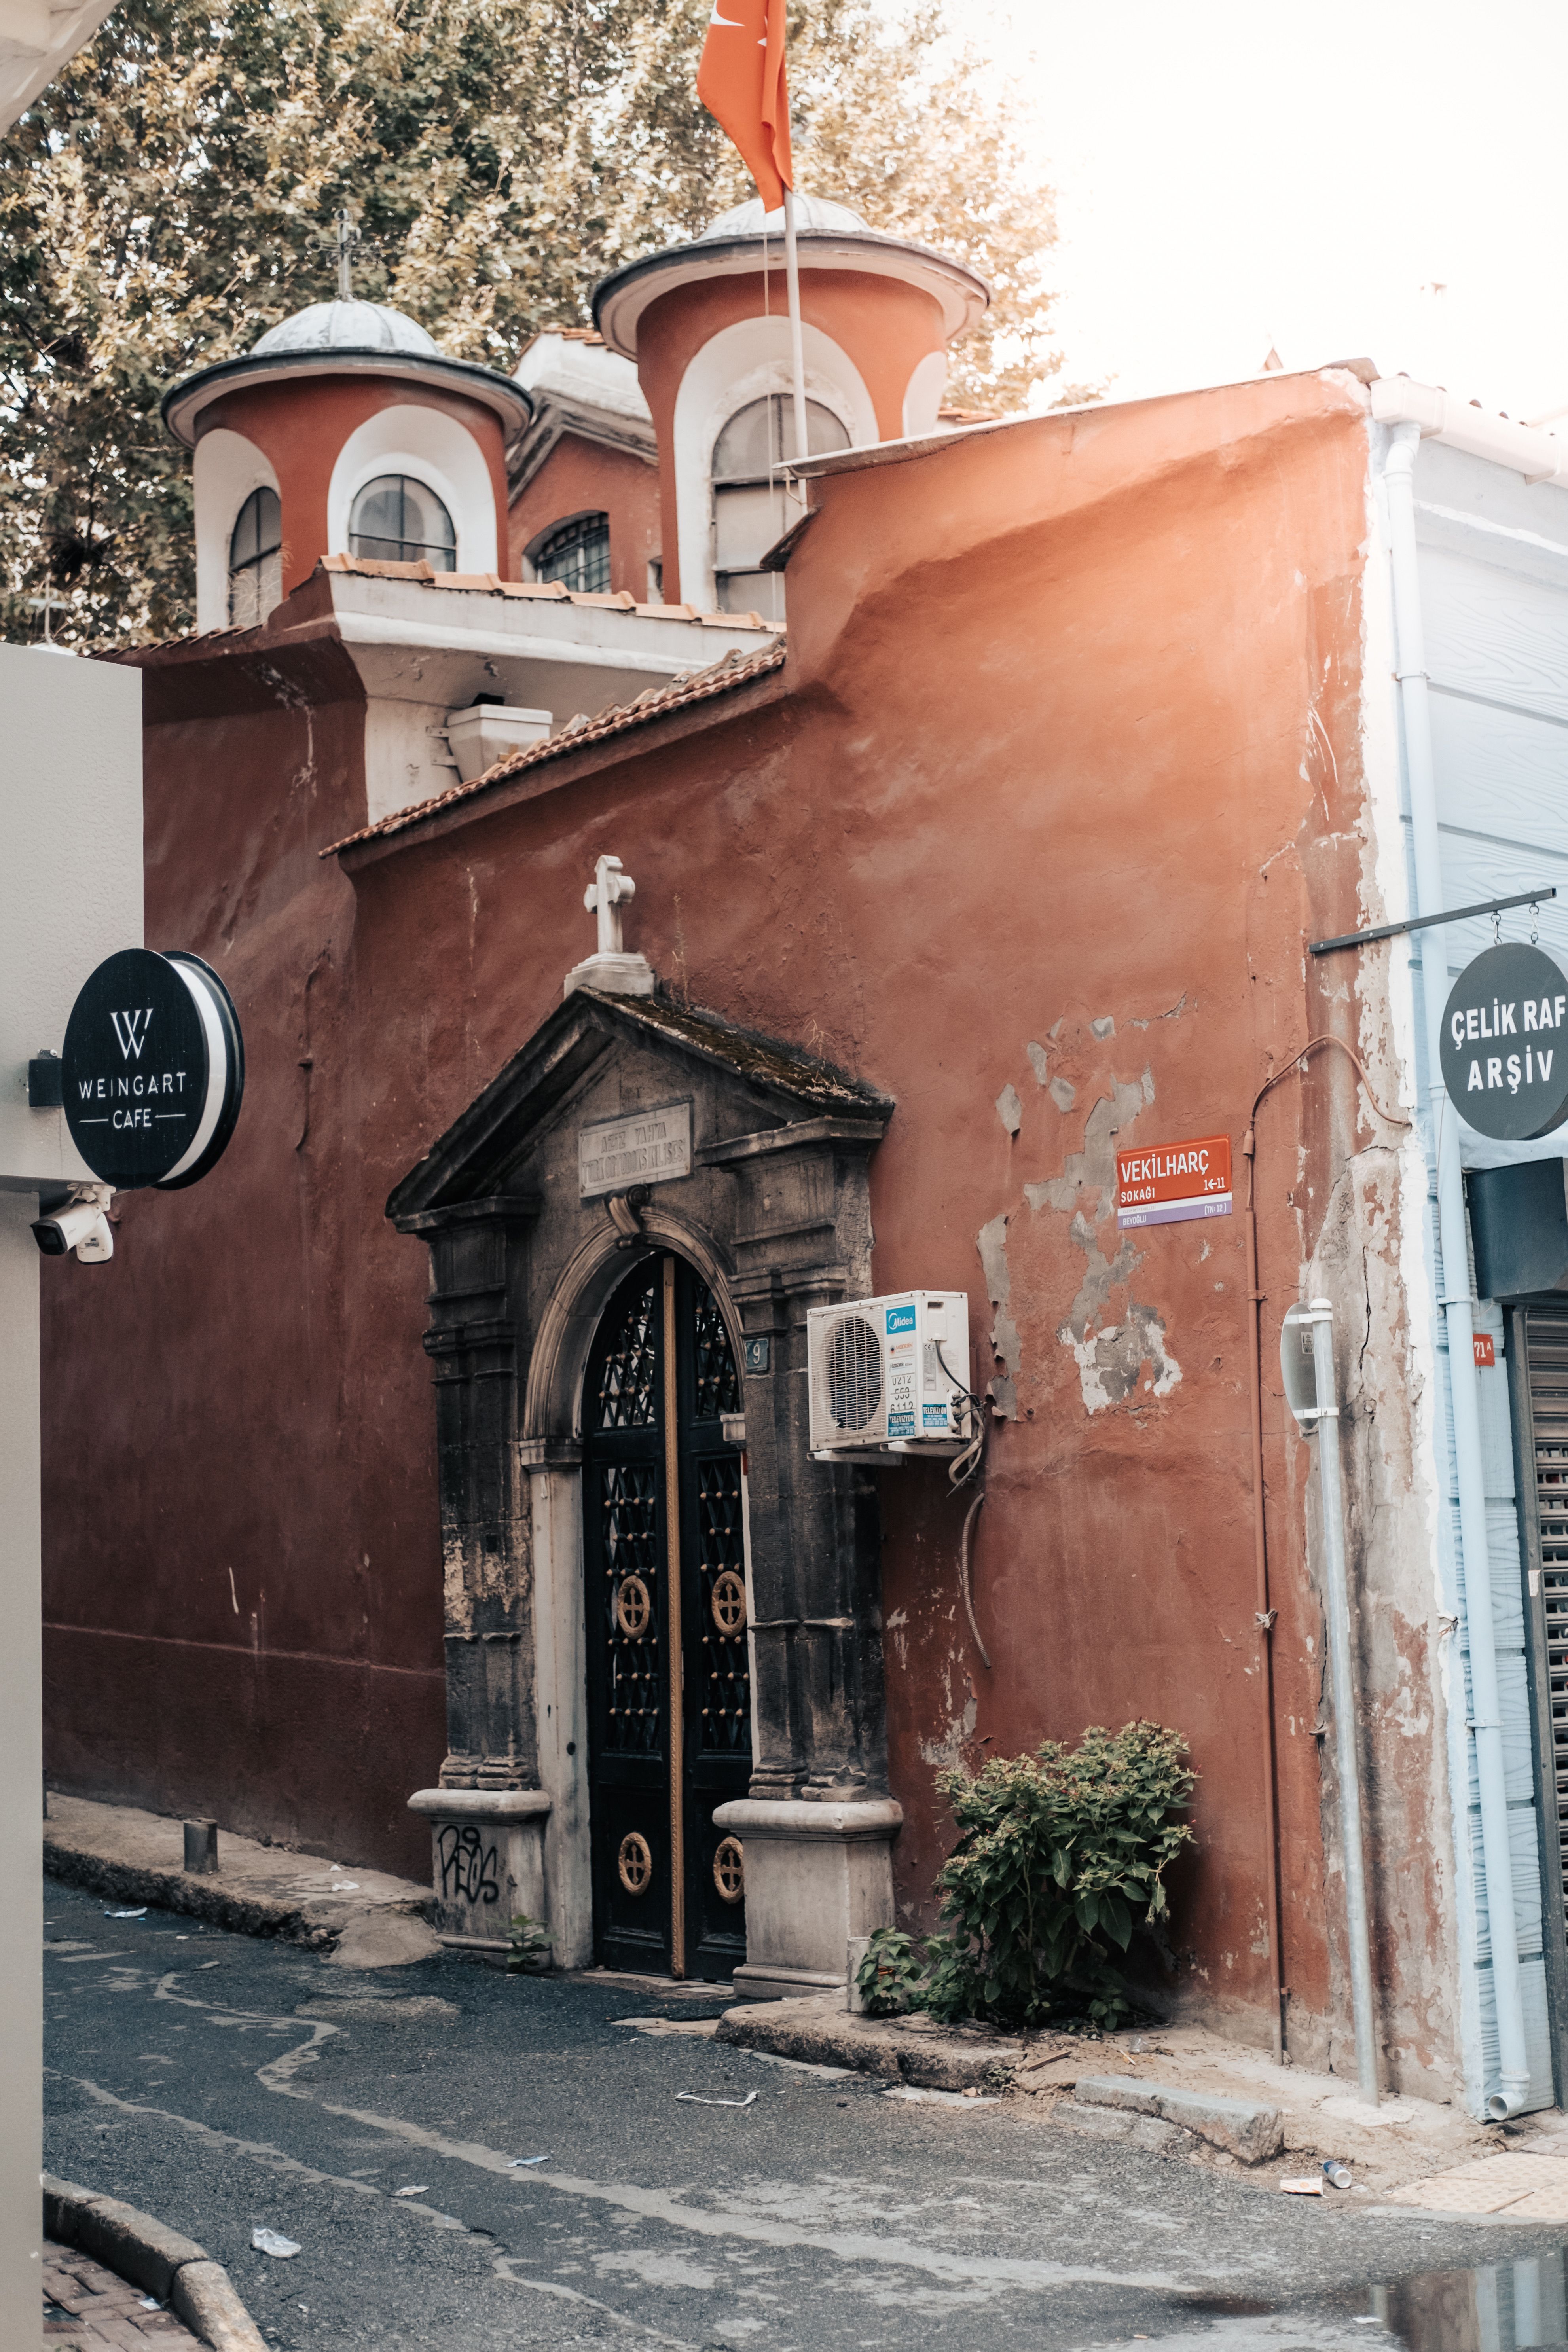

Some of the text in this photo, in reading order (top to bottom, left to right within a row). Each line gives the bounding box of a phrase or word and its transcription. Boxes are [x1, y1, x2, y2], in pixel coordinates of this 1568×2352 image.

[110, 1008, 154, 1060] W
[1451, 995, 1566, 1050] ÇELİK RAF
[1467, 1044, 1554, 1094] ARŞİV
[79, 1071, 186, 1099] WEINGART
[112, 1108, 152, 1129] CAFE
[1121, 1149, 1209, 1183] VEKİLHARÇ
[1121, 1186, 1155, 1203] SOKAĞI
[1123, 1215, 1147, 1226] BEYOĞLU
[889, 1313, 914, 1330] Midea
[753, 1343, 760, 1364] 9
